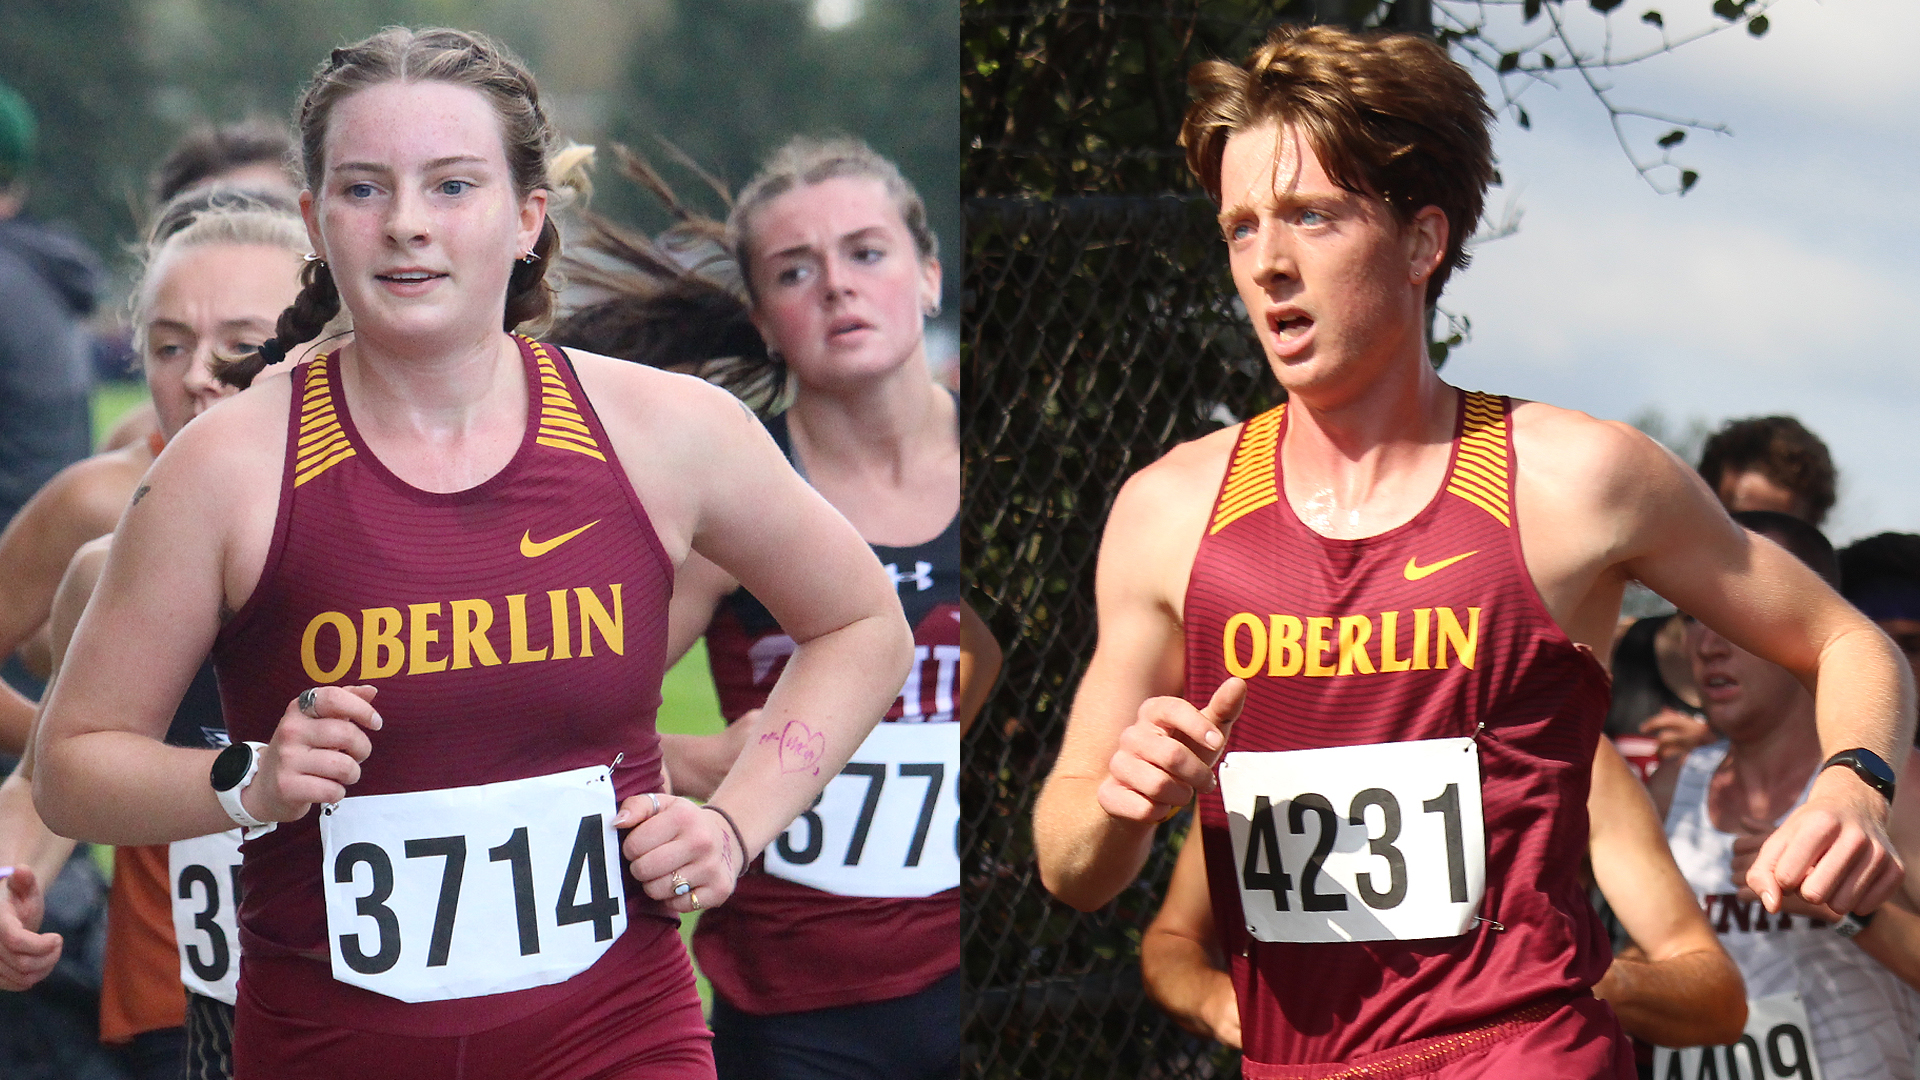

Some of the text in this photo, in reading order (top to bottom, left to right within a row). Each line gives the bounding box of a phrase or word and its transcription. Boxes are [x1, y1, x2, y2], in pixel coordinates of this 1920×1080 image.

[301, 584, 624, 684] OBERLIN
[1224, 607, 1481, 679] OBERLIN
[776, 762, 960, 866] 377
[1243, 783, 1469, 913] 4231
[178, 864, 243, 982] 3
[334, 813, 620, 975] 3714
